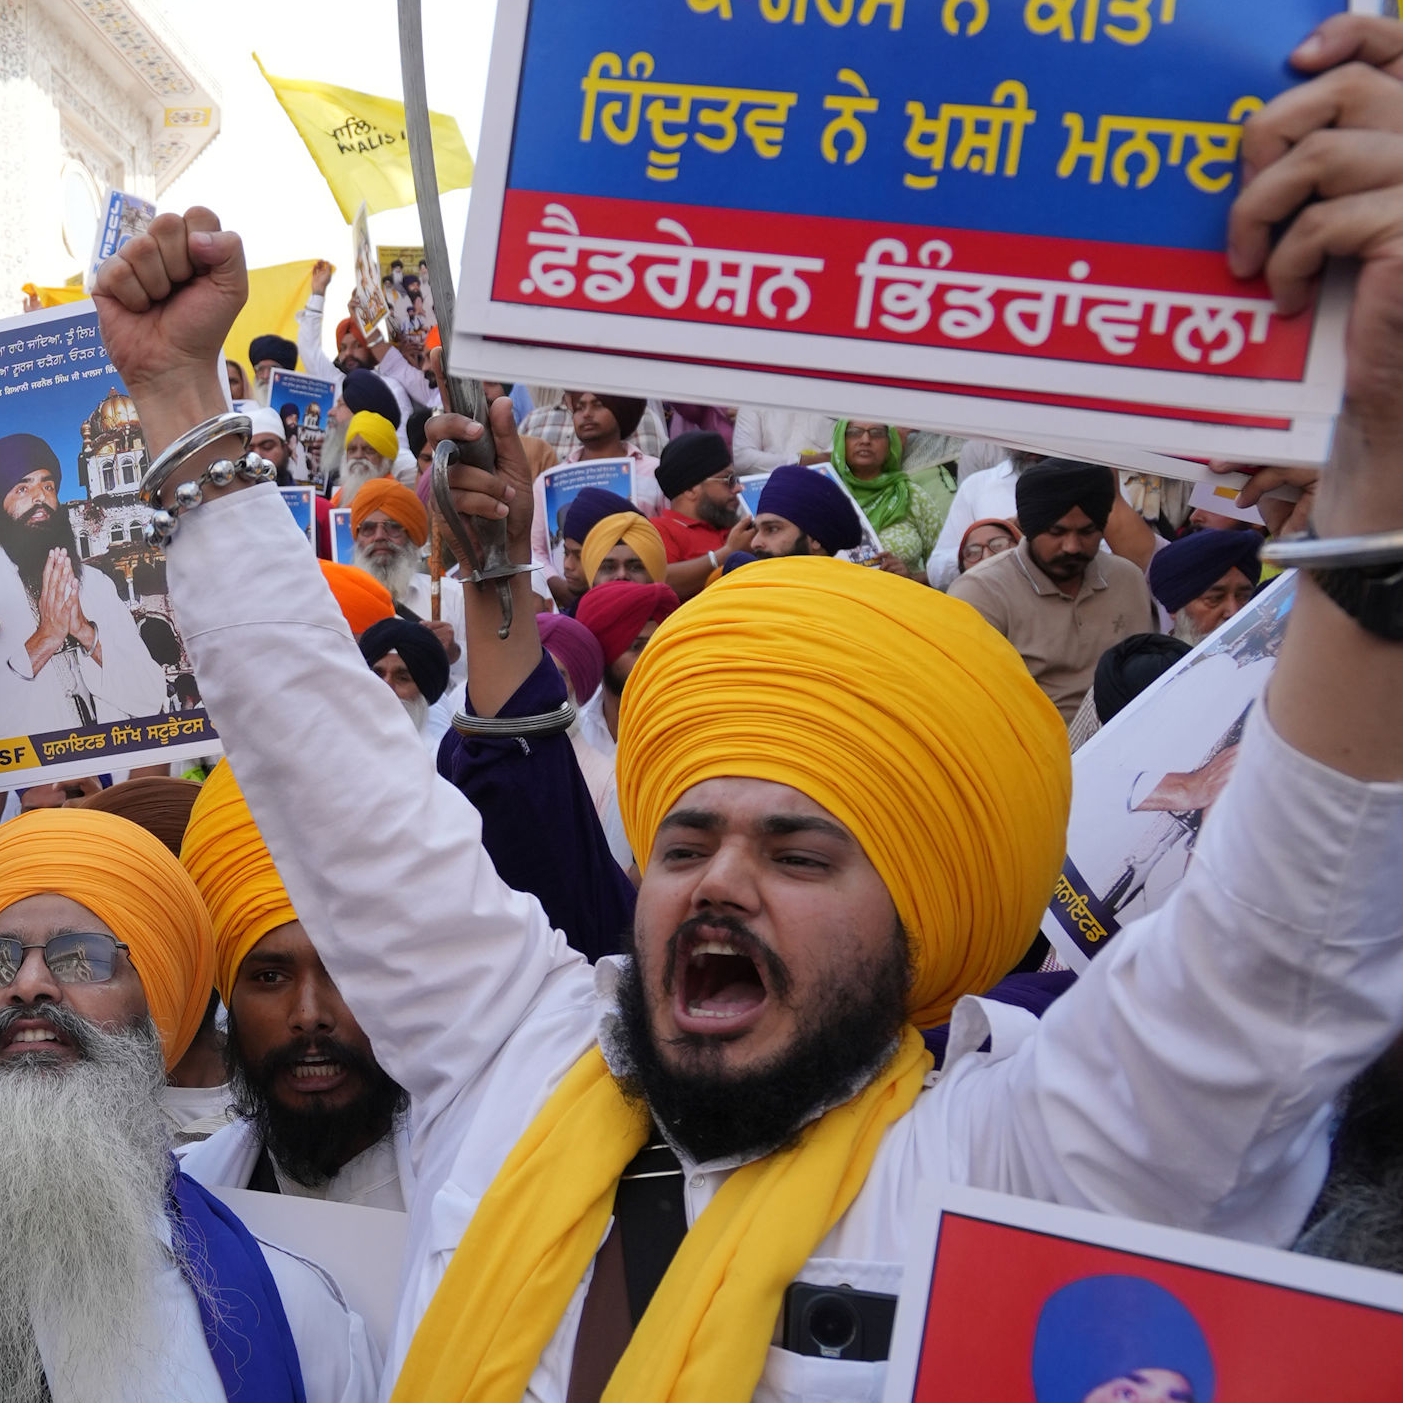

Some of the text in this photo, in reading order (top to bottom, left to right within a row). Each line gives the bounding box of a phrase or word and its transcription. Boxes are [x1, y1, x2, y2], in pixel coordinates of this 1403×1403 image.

[579, 51, 798, 181] ਹਿੰਦੂਤਵ
[820, 68, 879, 166] ਨੇ
[903, 80, 1036, 190] ਖੁਸ਼ੀ
[519, 203, 1280, 366] ਫ਼ੈਡਰੇਸ਼ਨ ਭਿੰਡਰਾਂਵਾਲਾ
[42, 732, 106, 761] ਯੁਨਾਇਟਡ
[110, 724, 142, 747] ਸਿੱਖ
